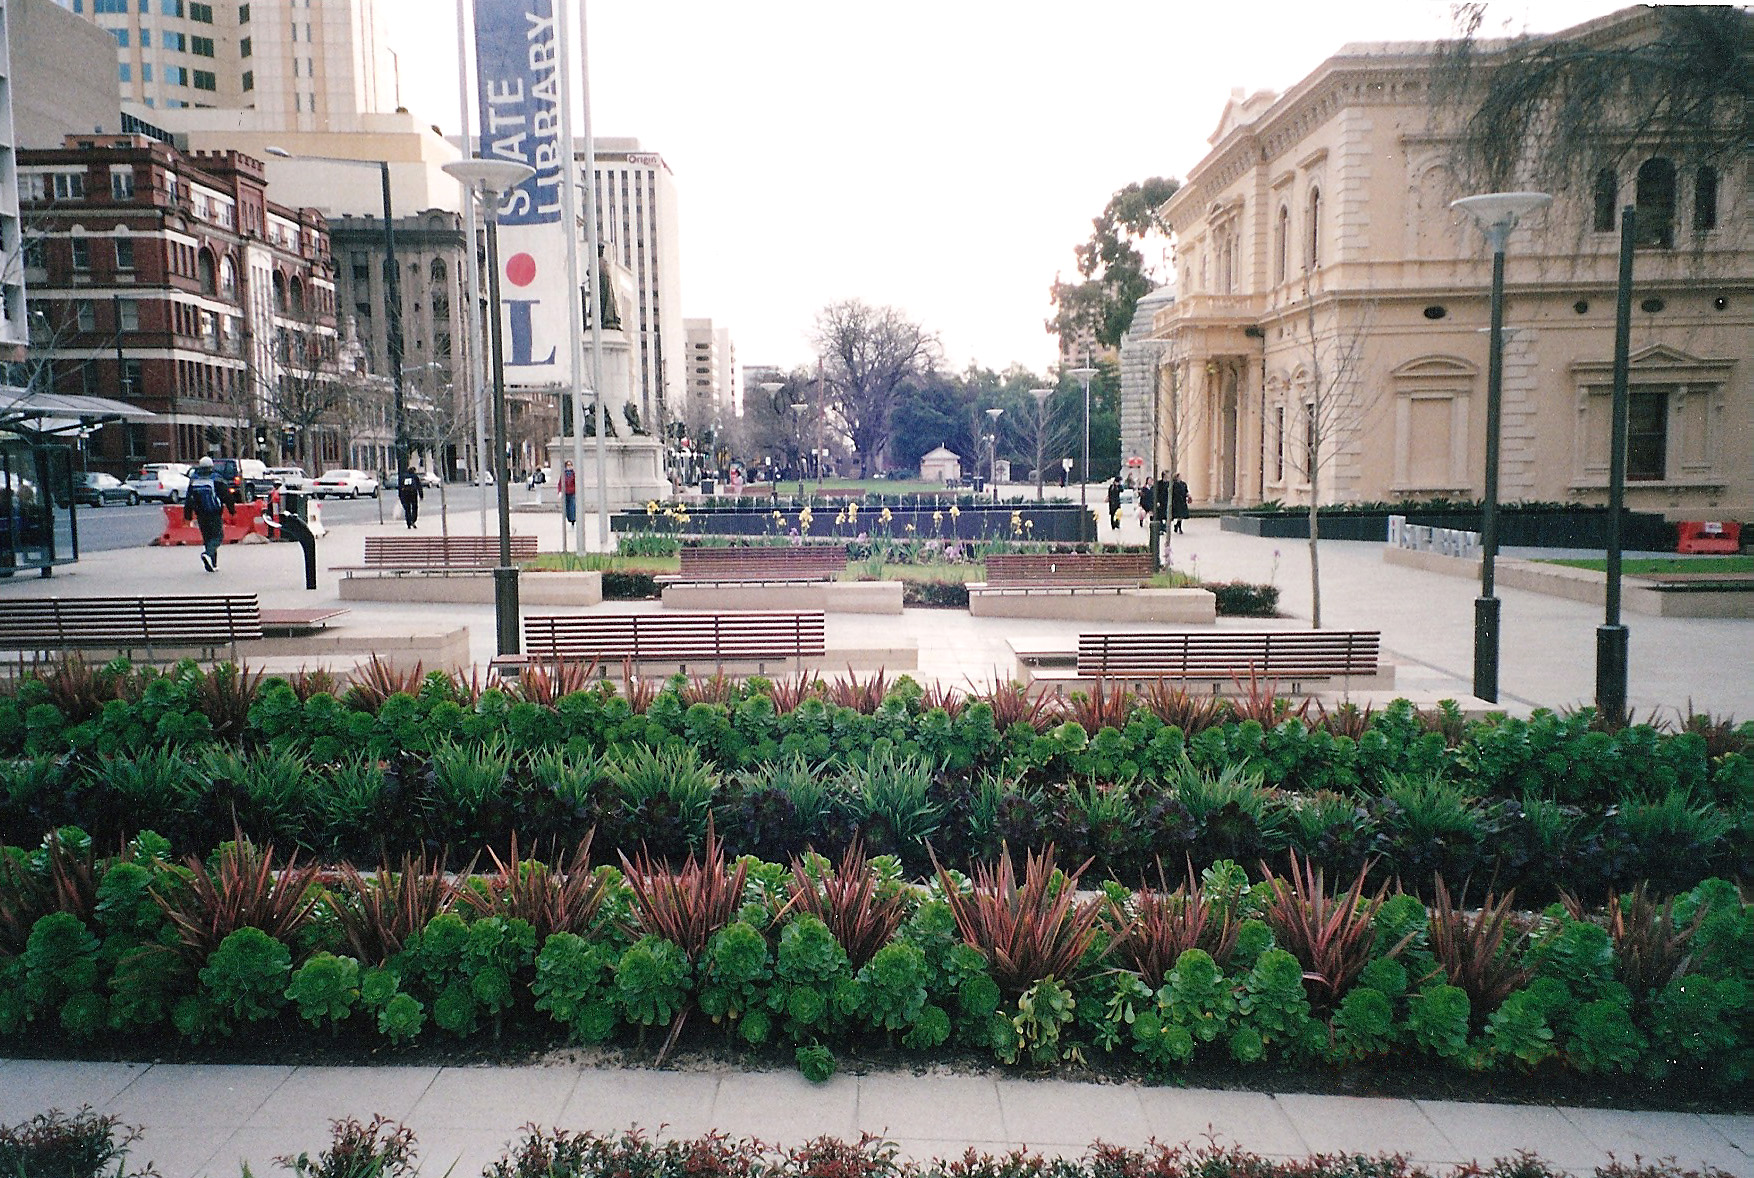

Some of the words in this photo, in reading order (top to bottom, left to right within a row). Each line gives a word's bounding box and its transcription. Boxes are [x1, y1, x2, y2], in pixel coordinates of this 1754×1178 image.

[487, 77, 530, 216] SATE
[525, 11, 564, 215] LIBRARY
[628, 154, 657, 166] Origin
